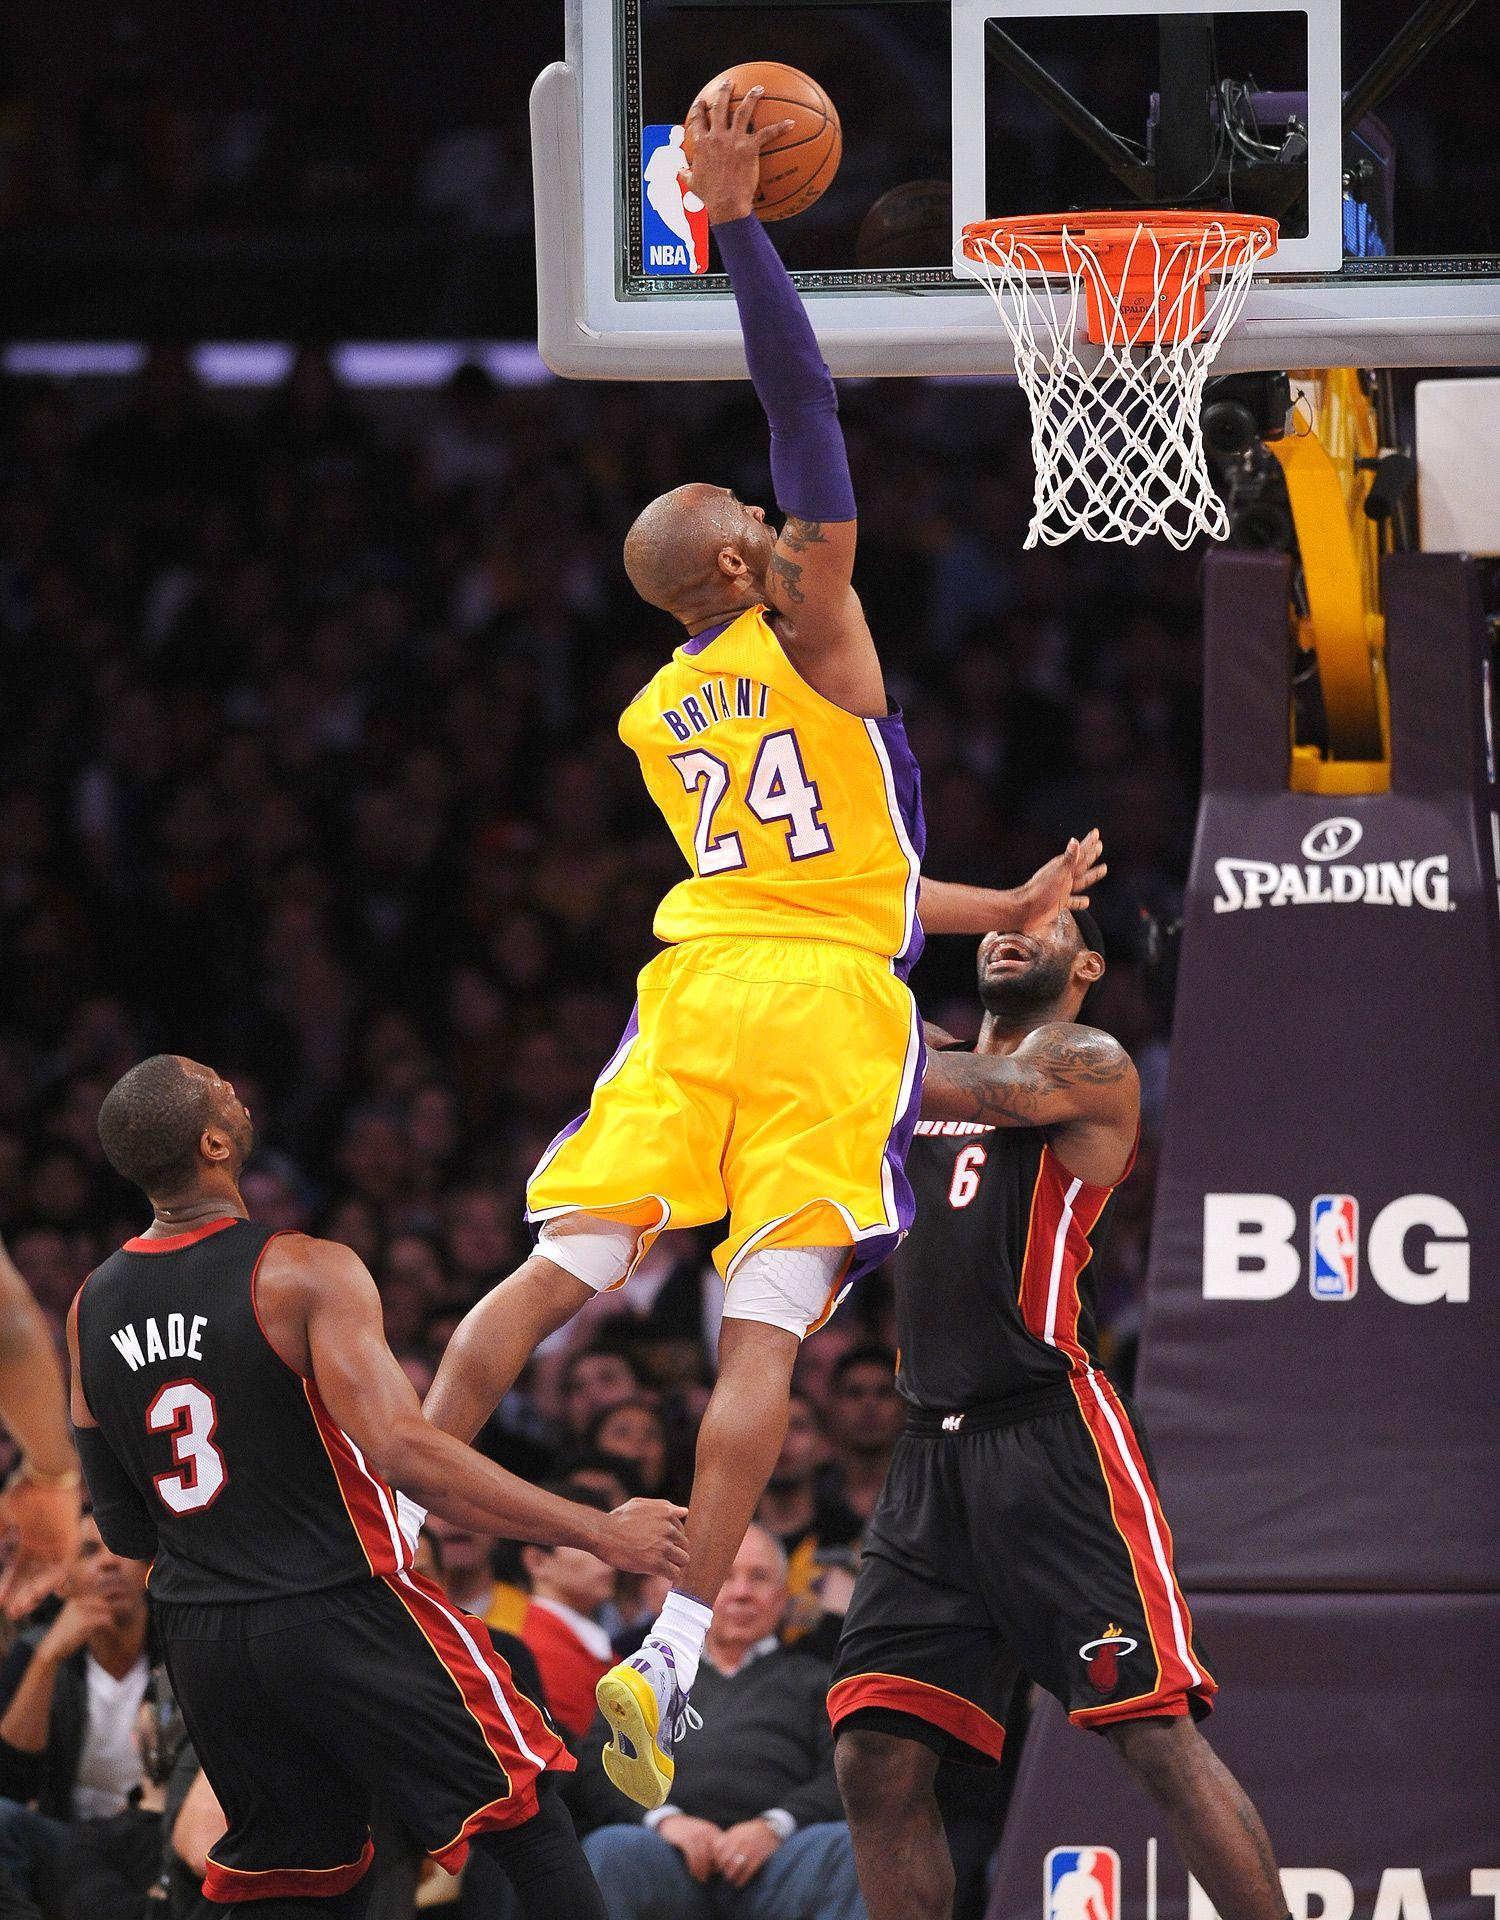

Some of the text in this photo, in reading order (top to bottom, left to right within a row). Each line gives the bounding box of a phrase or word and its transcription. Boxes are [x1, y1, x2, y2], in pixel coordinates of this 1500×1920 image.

[650, 245, 687, 266] NBA
[661, 677, 771, 743] BRYANT
[667, 728, 835, 877] 24
[1213, 854, 1450, 914] SPALDING
[948, 1143, 988, 1210] 6
[110, 1312, 208, 1372] WADE
[145, 1377, 230, 1518] 3
